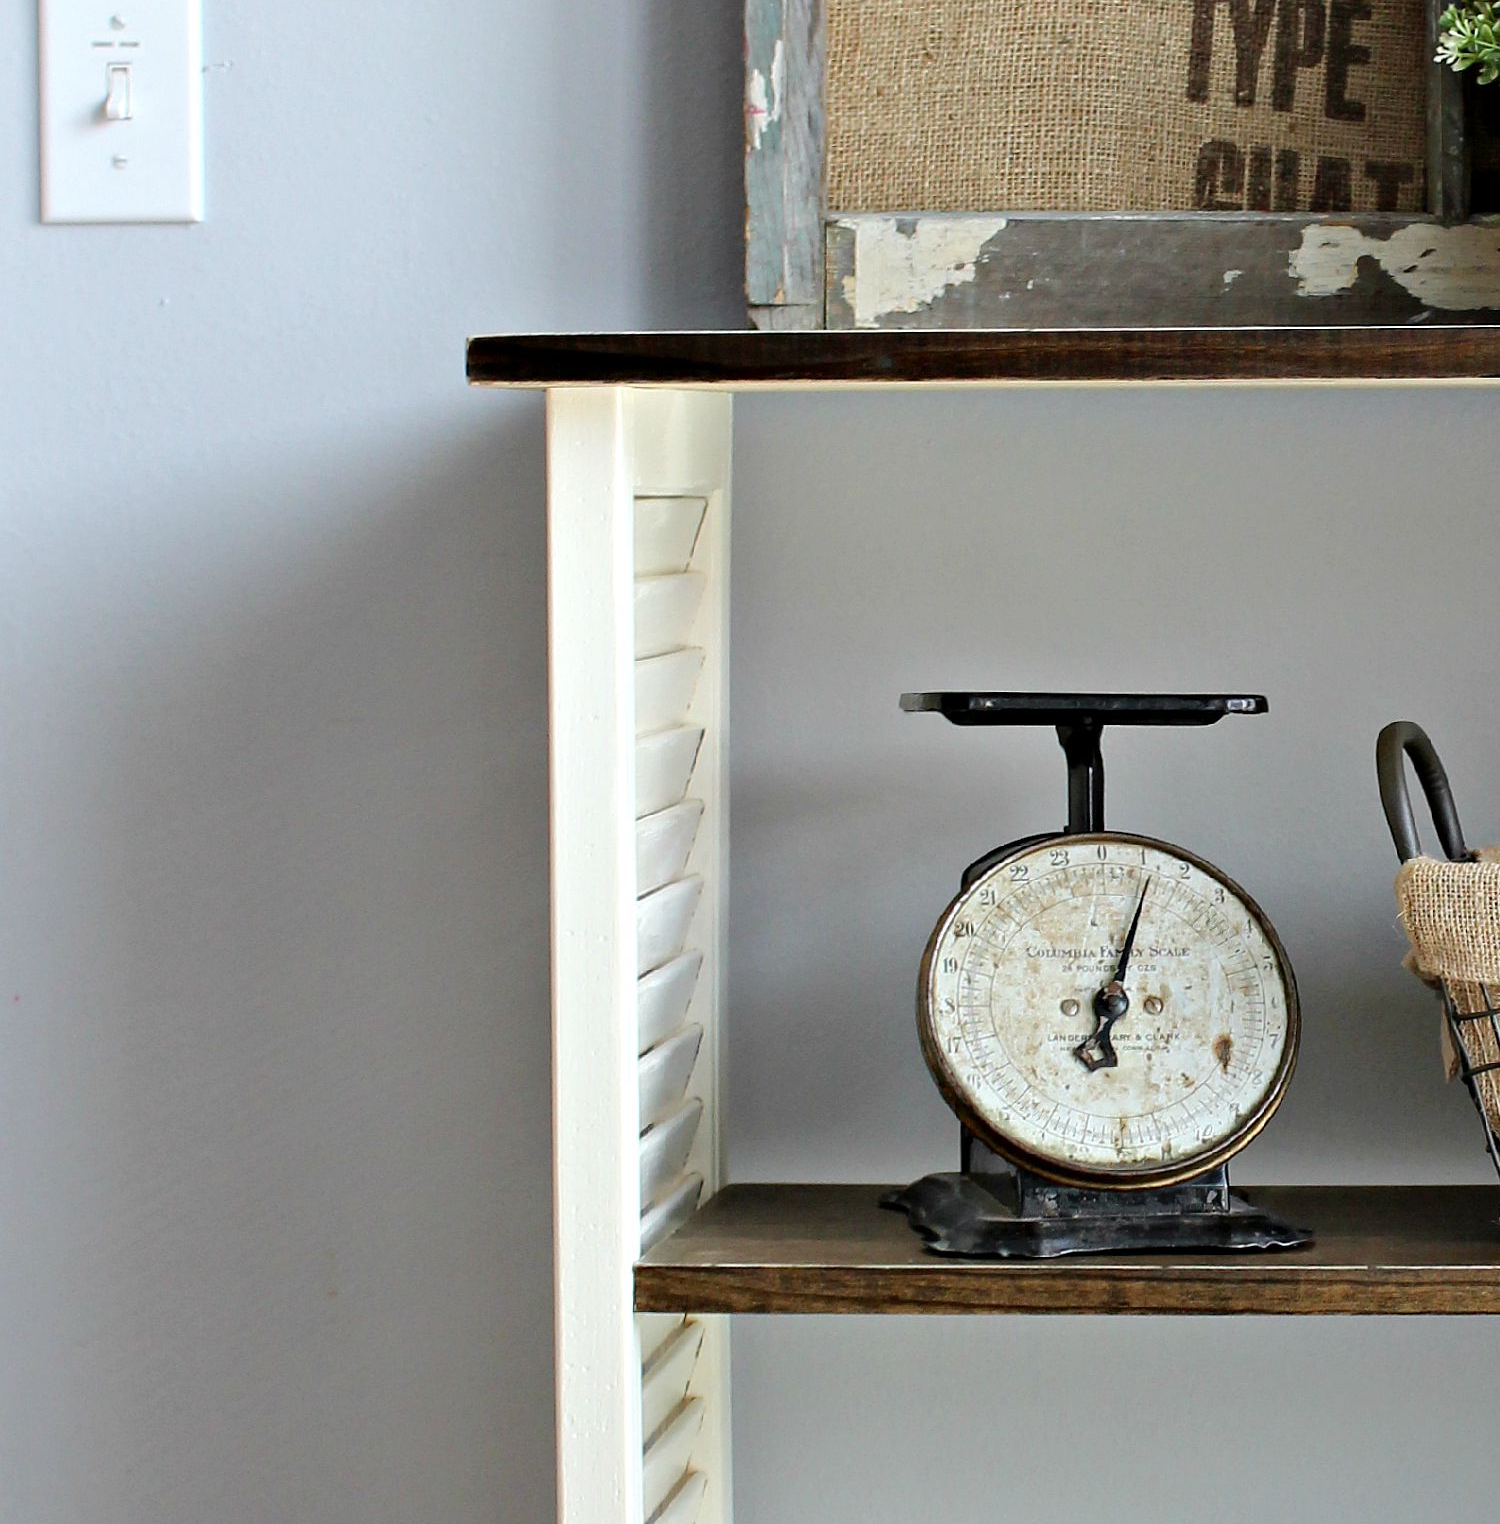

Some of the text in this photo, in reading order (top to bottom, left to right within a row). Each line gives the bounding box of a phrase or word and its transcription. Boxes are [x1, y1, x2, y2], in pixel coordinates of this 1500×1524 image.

[1050, 850, 1070, 866] 23
[1097, 846, 1107, 861] 0
[1140, 848, 1147, 865] 1
[1009, 865, 1030, 882] 22
[1179, 864, 1191, 879] 2
[980, 889, 996, 906] 21
[1215, 888, 1225, 904] 3
[953, 922, 975, 938] 20
[1100, 945, 1145, 958] FAMLY
[1149, 946, 1191, 958] SCALE
[943, 957, 958, 974] 19
